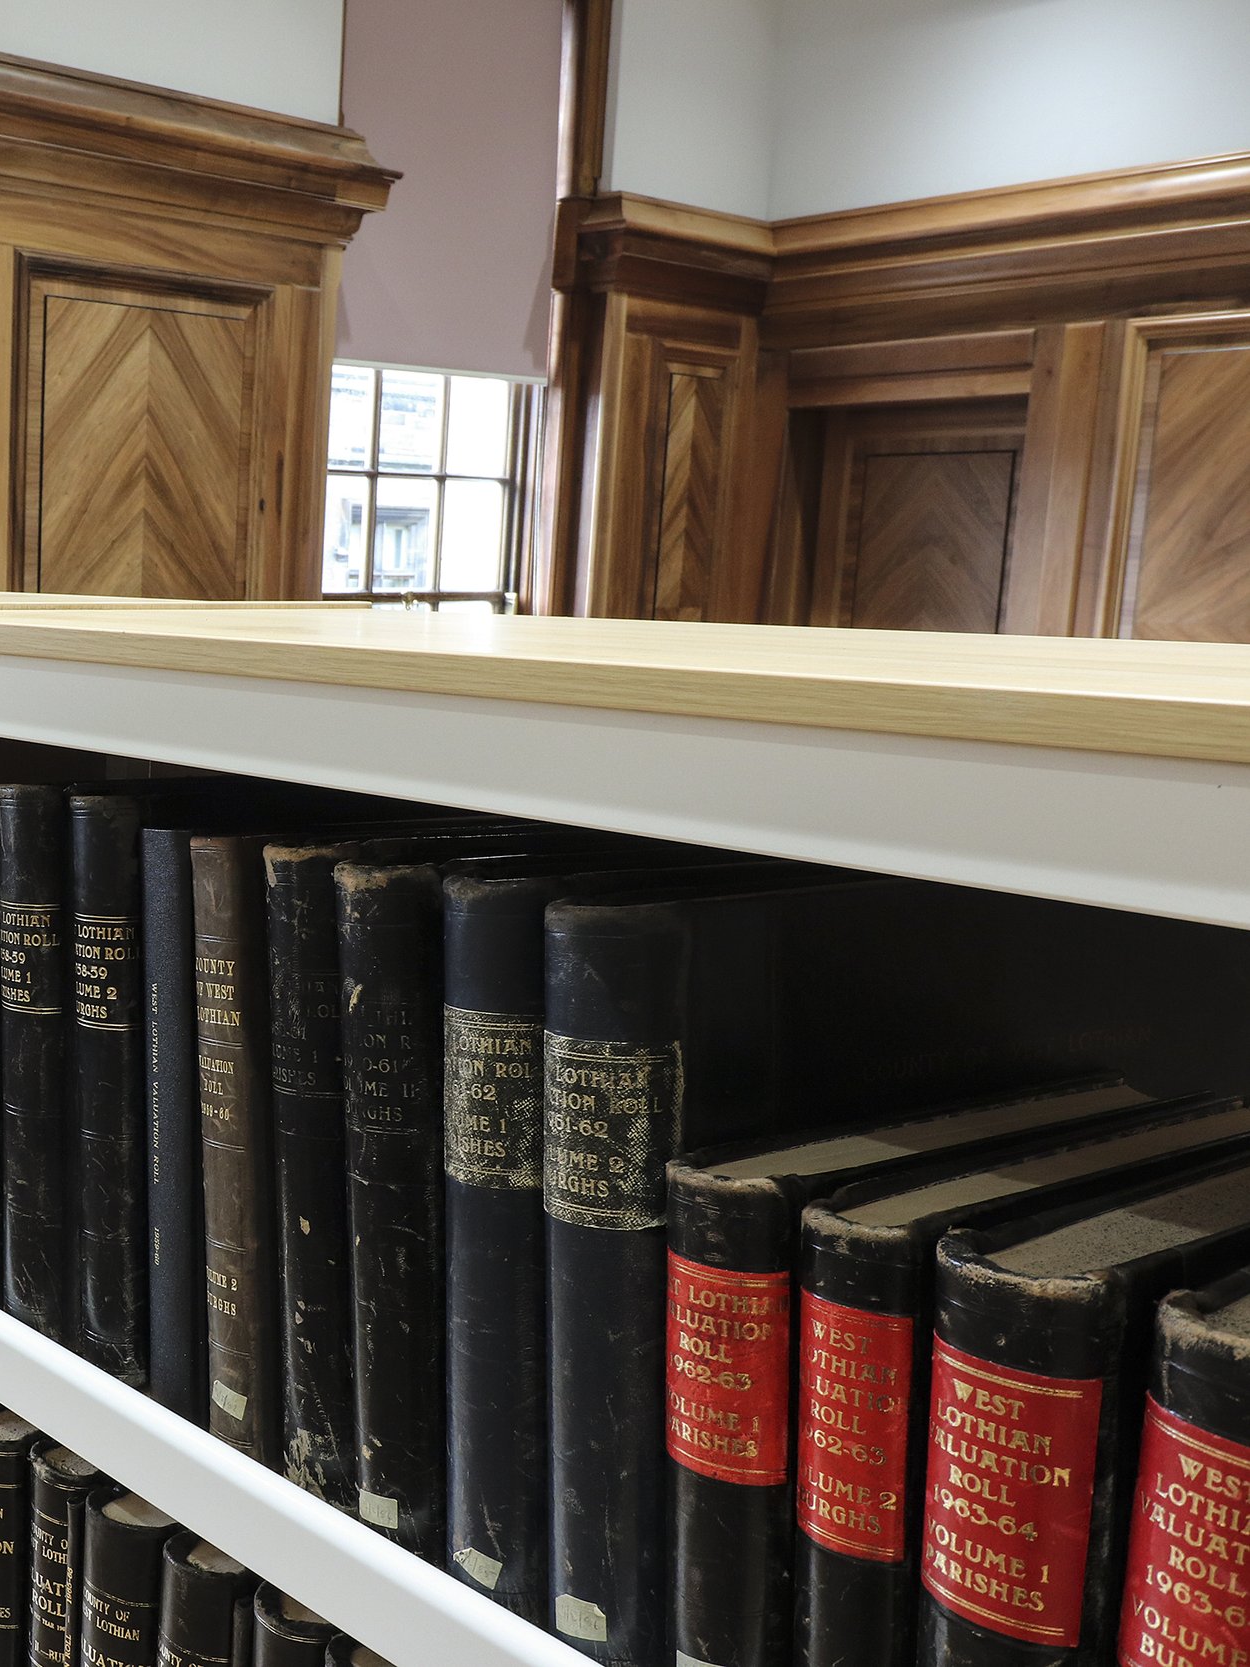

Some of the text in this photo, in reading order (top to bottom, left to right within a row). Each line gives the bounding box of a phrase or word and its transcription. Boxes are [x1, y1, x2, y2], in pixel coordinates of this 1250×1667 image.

[2, 911, 51, 928] LOTHIAN
[77, 924, 135, 941] LOTHIAN
[23, 934, 60, 948] ROLL
[25, 973, 32, 984] 1
[106, 987, 118, 1000] 2
[206, 982, 235, 1001] WEST
[197, 1005, 241, 1027] LOTHIAN
[150, 1021, 159, 1073] LOTHIAN
[152, 1081, 160, 1149] VALUATION
[499, 1118, 507, 1135] 1
[231, 1278, 238, 1291] 2
[679, 1331, 733, 1364] ROLL
[810, 1318, 872, 1355] WEST
[670, 1354, 752, 1392] 1962-63
[669, 1390, 760, 1433] OLUME 1
[811, 1399, 867, 1435] ROLL
[952, 1378, 1025, 1421] WEST
[669, 1415, 758, 1458] ARISHES
[937, 1398, 1053, 1457] LOTHIAN
[929, 1416, 1072, 1488] VALUATION
[803, 1463, 898, 1512] LUME 2
[949, 1463, 1017, 1507] ROLL
[933, 1483, 1038, 1542] 1963-64
[928, 1513, 1049, 1584] VOLUME 1
[925, 1540, 1045, 1612] PARISHES
[1168, 1544, 1247, 1599] ROLL
[32, 1587, 67, 1618] ROLL
[115, 1609, 131, 1623] OF
[96, 1615, 141, 1642] LOTHIAN
